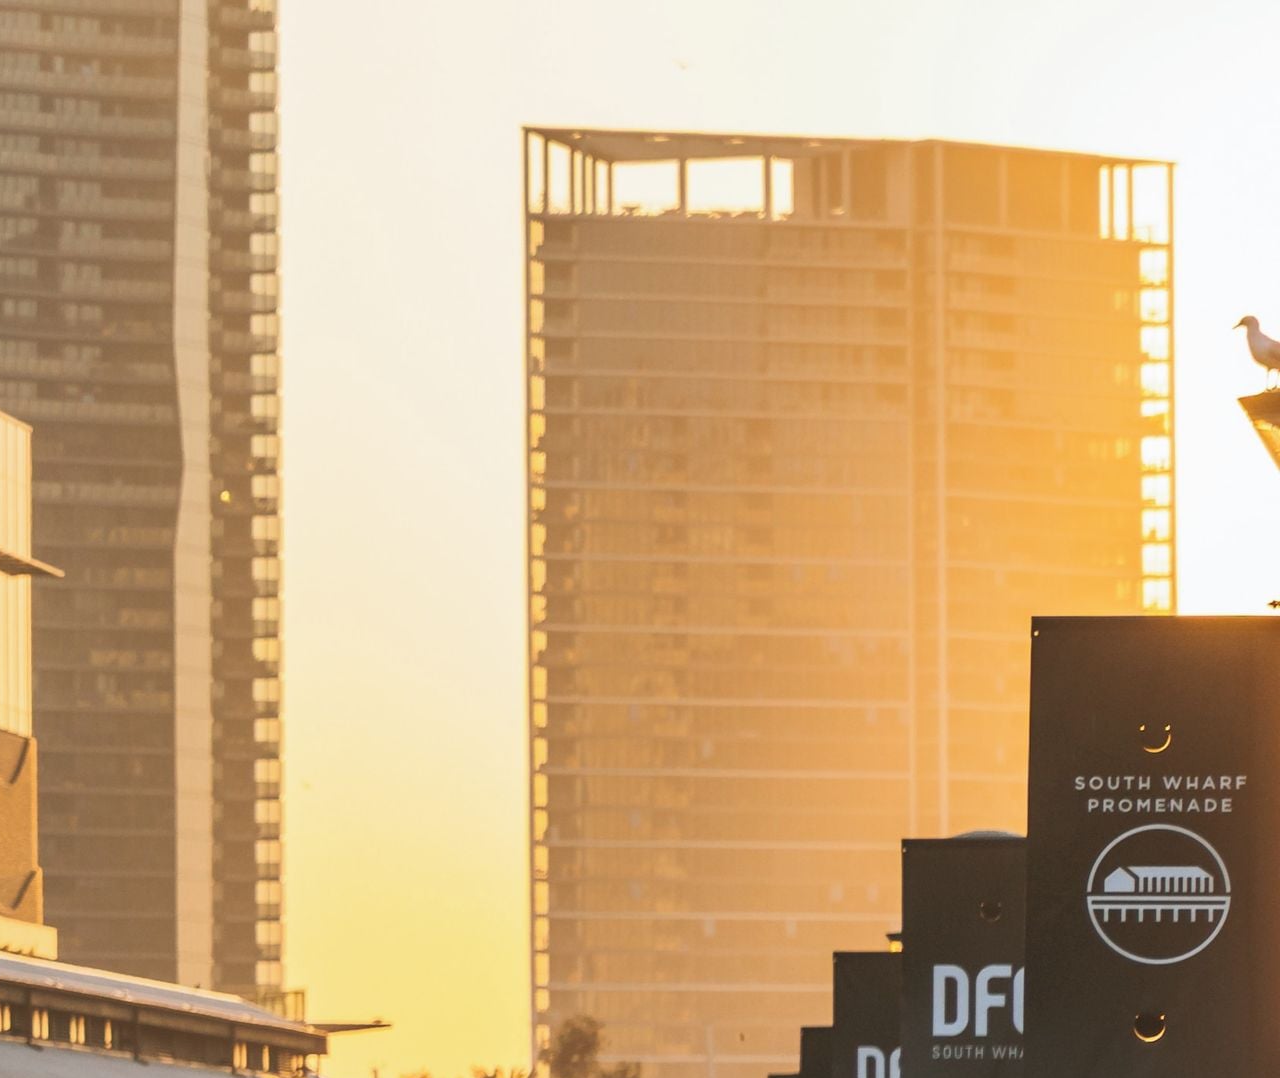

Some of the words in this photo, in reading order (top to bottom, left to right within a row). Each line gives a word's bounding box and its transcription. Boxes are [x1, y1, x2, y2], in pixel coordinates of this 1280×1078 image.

[1074, 776, 1151, 790] SOUTH
[1162, 775, 1247, 790] WHARF
[1087, 798, 1233, 813] PROMENADE
[932, 1045, 984, 1060] SOUTH
